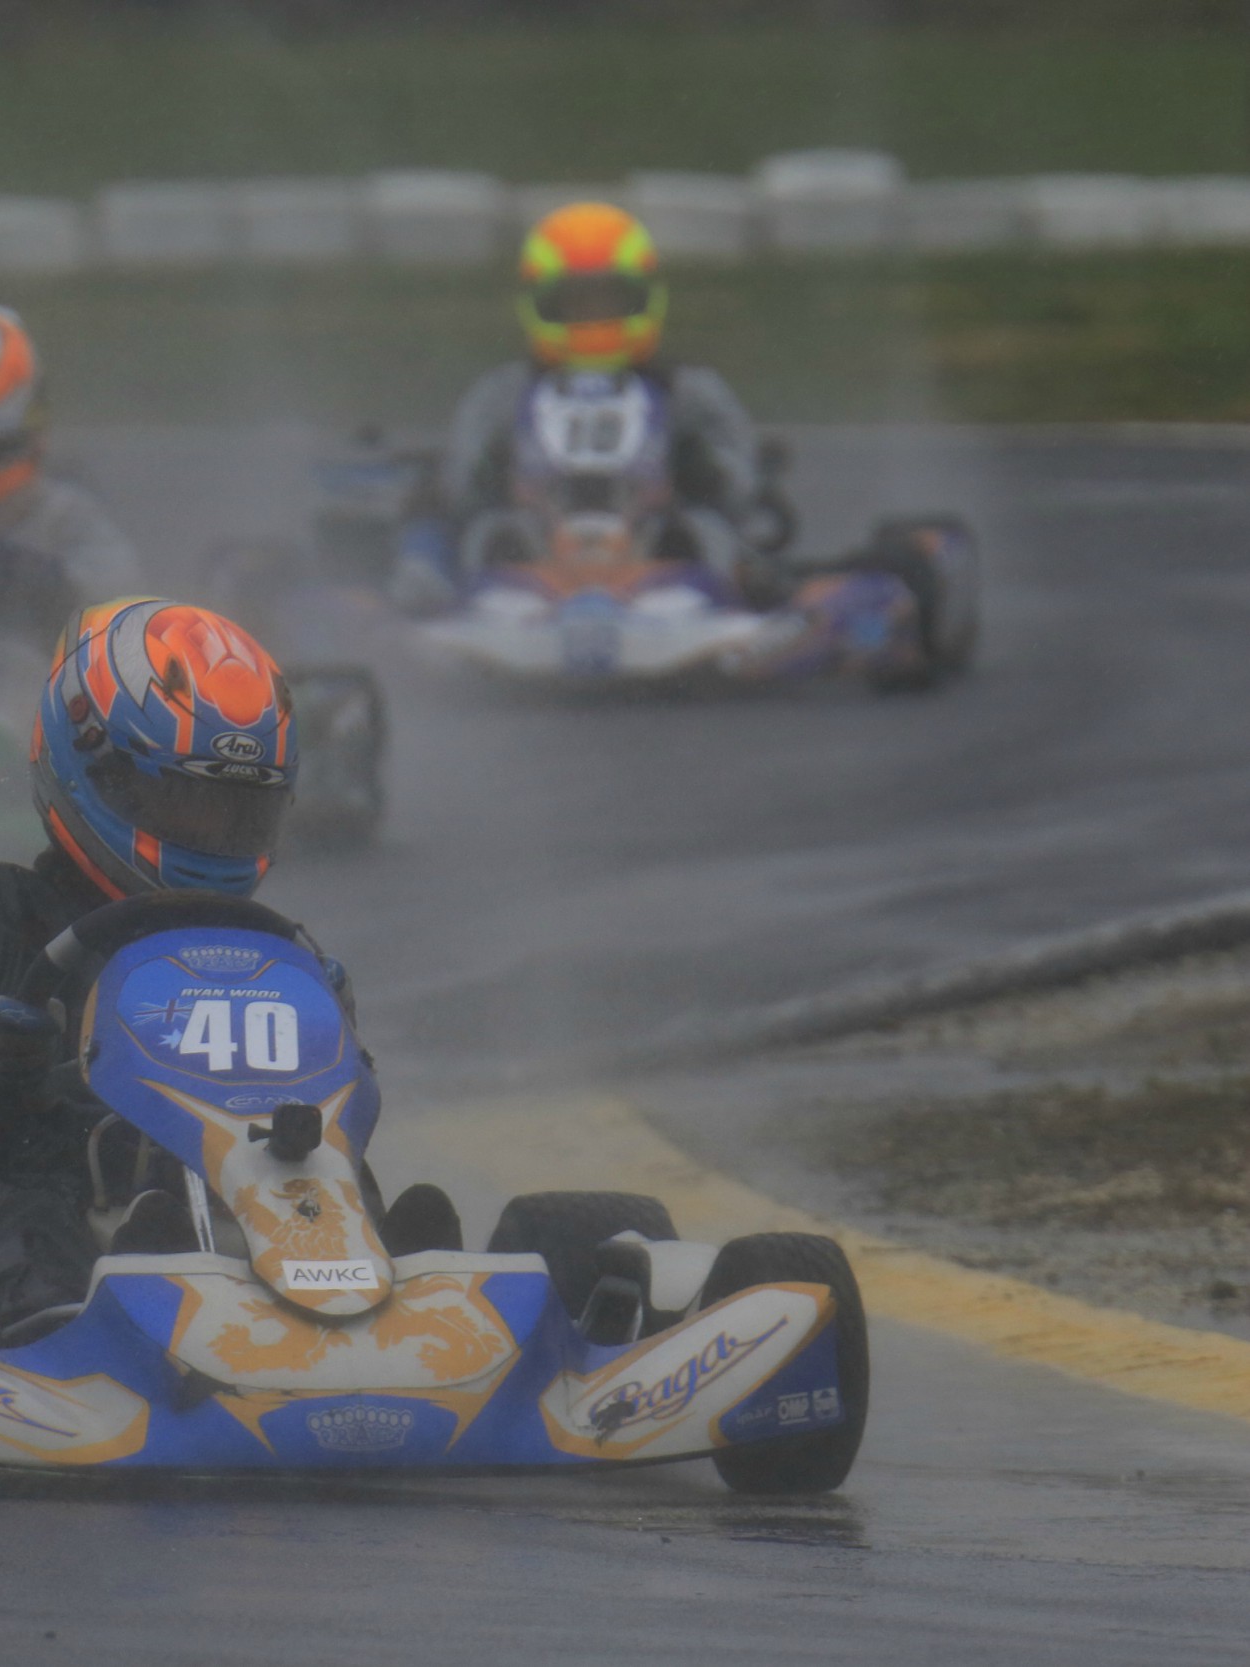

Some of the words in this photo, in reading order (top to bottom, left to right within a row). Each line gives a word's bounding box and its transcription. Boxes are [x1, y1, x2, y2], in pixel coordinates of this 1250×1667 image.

[180, 987, 226, 998] RYAN
[229, 988, 282, 999] WOOD
[178, 999, 300, 1072] 40
[293, 1266, 370, 1283] AWKC
